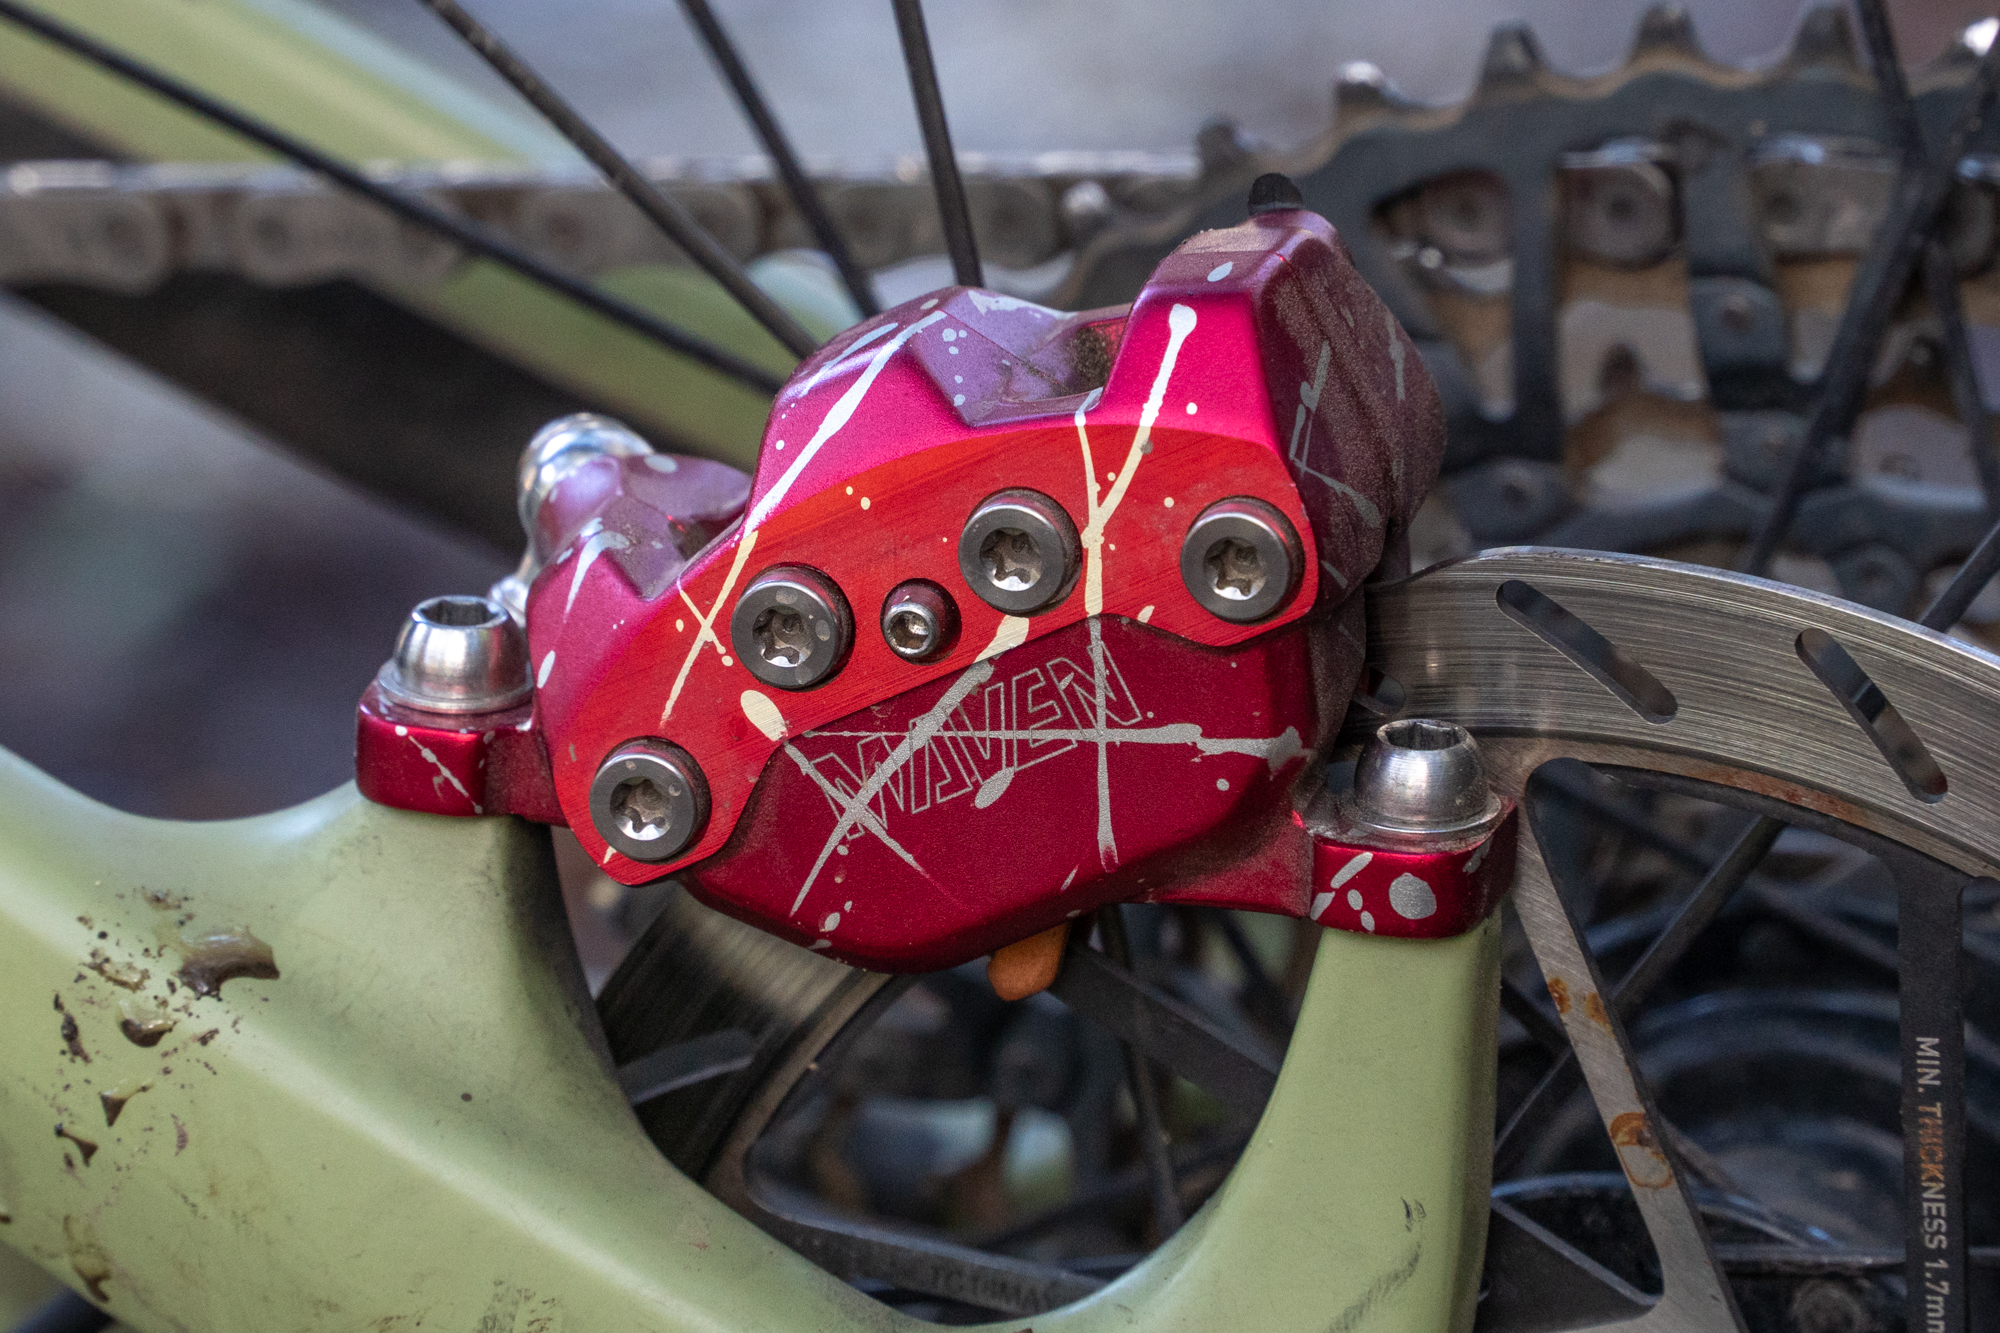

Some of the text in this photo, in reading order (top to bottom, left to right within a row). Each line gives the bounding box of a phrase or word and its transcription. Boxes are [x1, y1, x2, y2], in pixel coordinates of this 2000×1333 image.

[809, 640, 1143, 840] MAVEN
[1915, 1036, 1942, 1094] MIN.
[1918, 1101, 1948, 1250] THICKNESS
